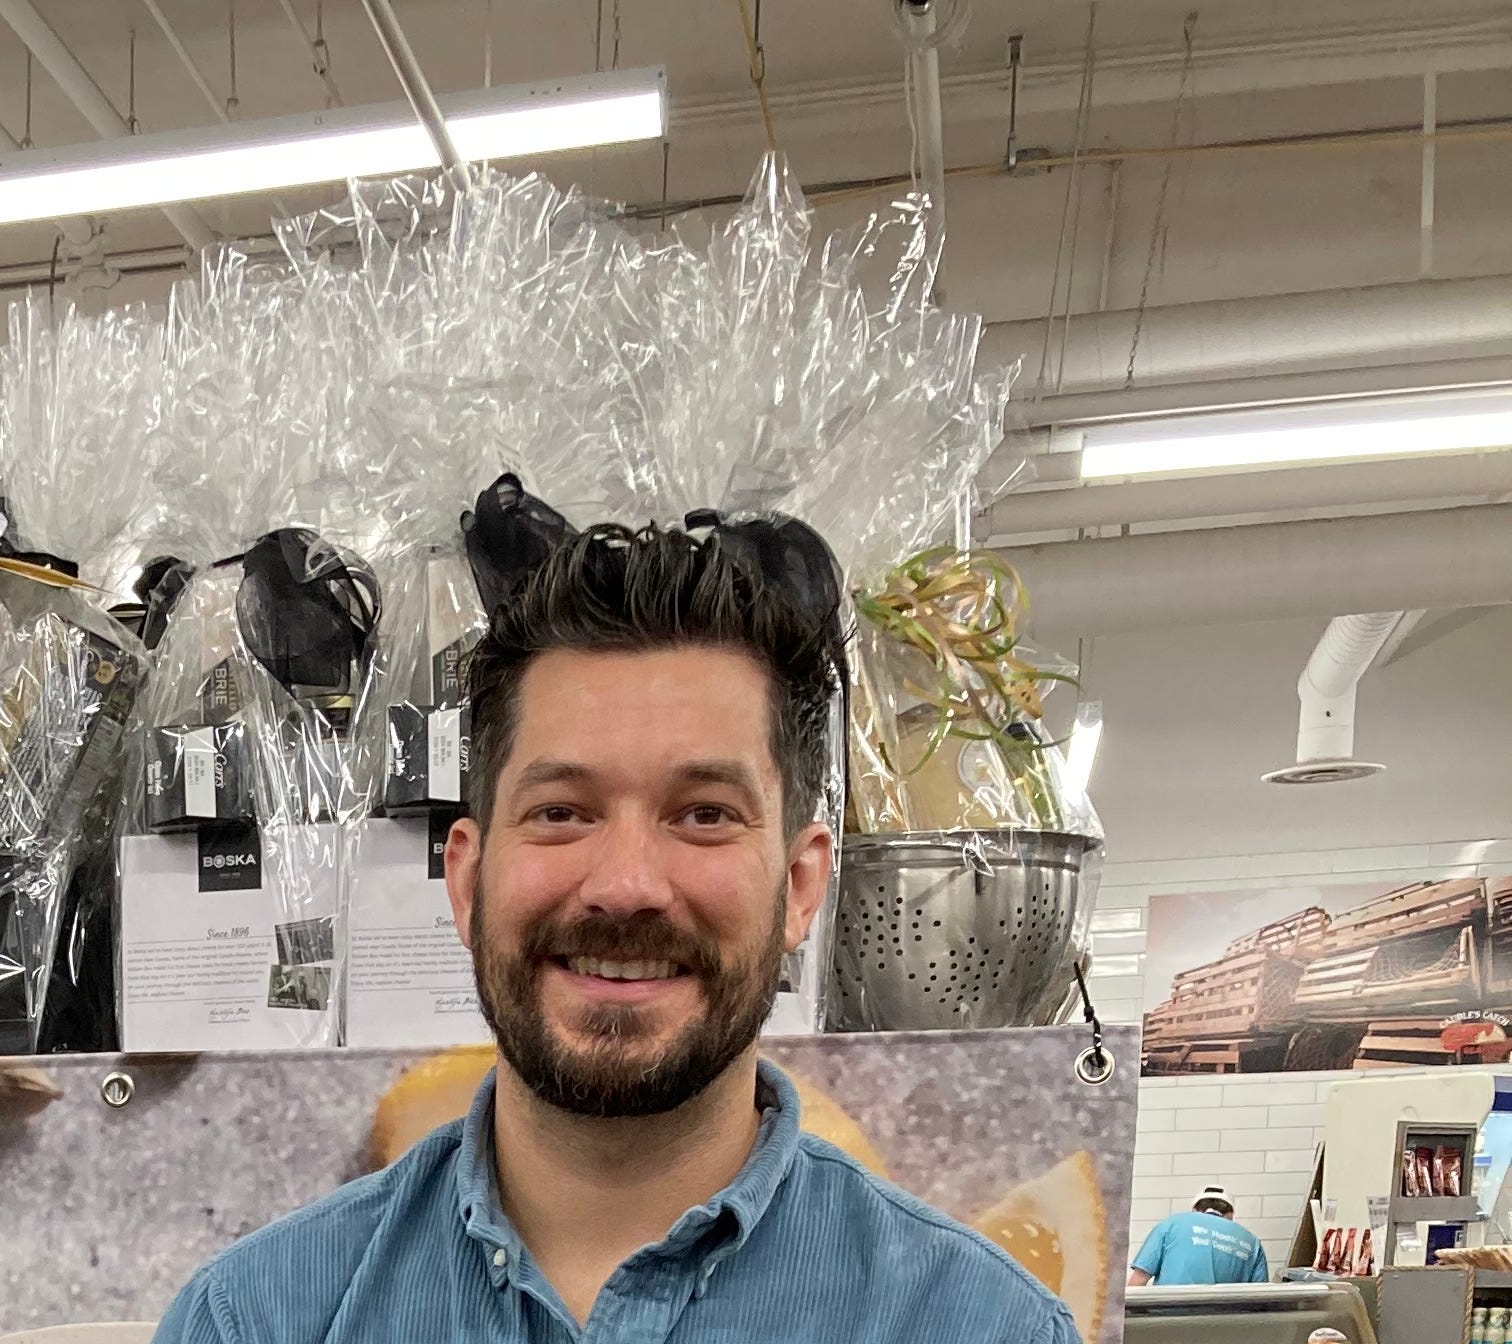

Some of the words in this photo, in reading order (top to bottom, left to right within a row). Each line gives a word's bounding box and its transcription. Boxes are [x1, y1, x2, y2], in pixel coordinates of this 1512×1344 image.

[215, 668, 228, 706] BRIE
[202, 853, 256, 868] BOSKA
[207, 928, 228, 940] Since
[1483, 1011, 1510, 1027] CATCH
